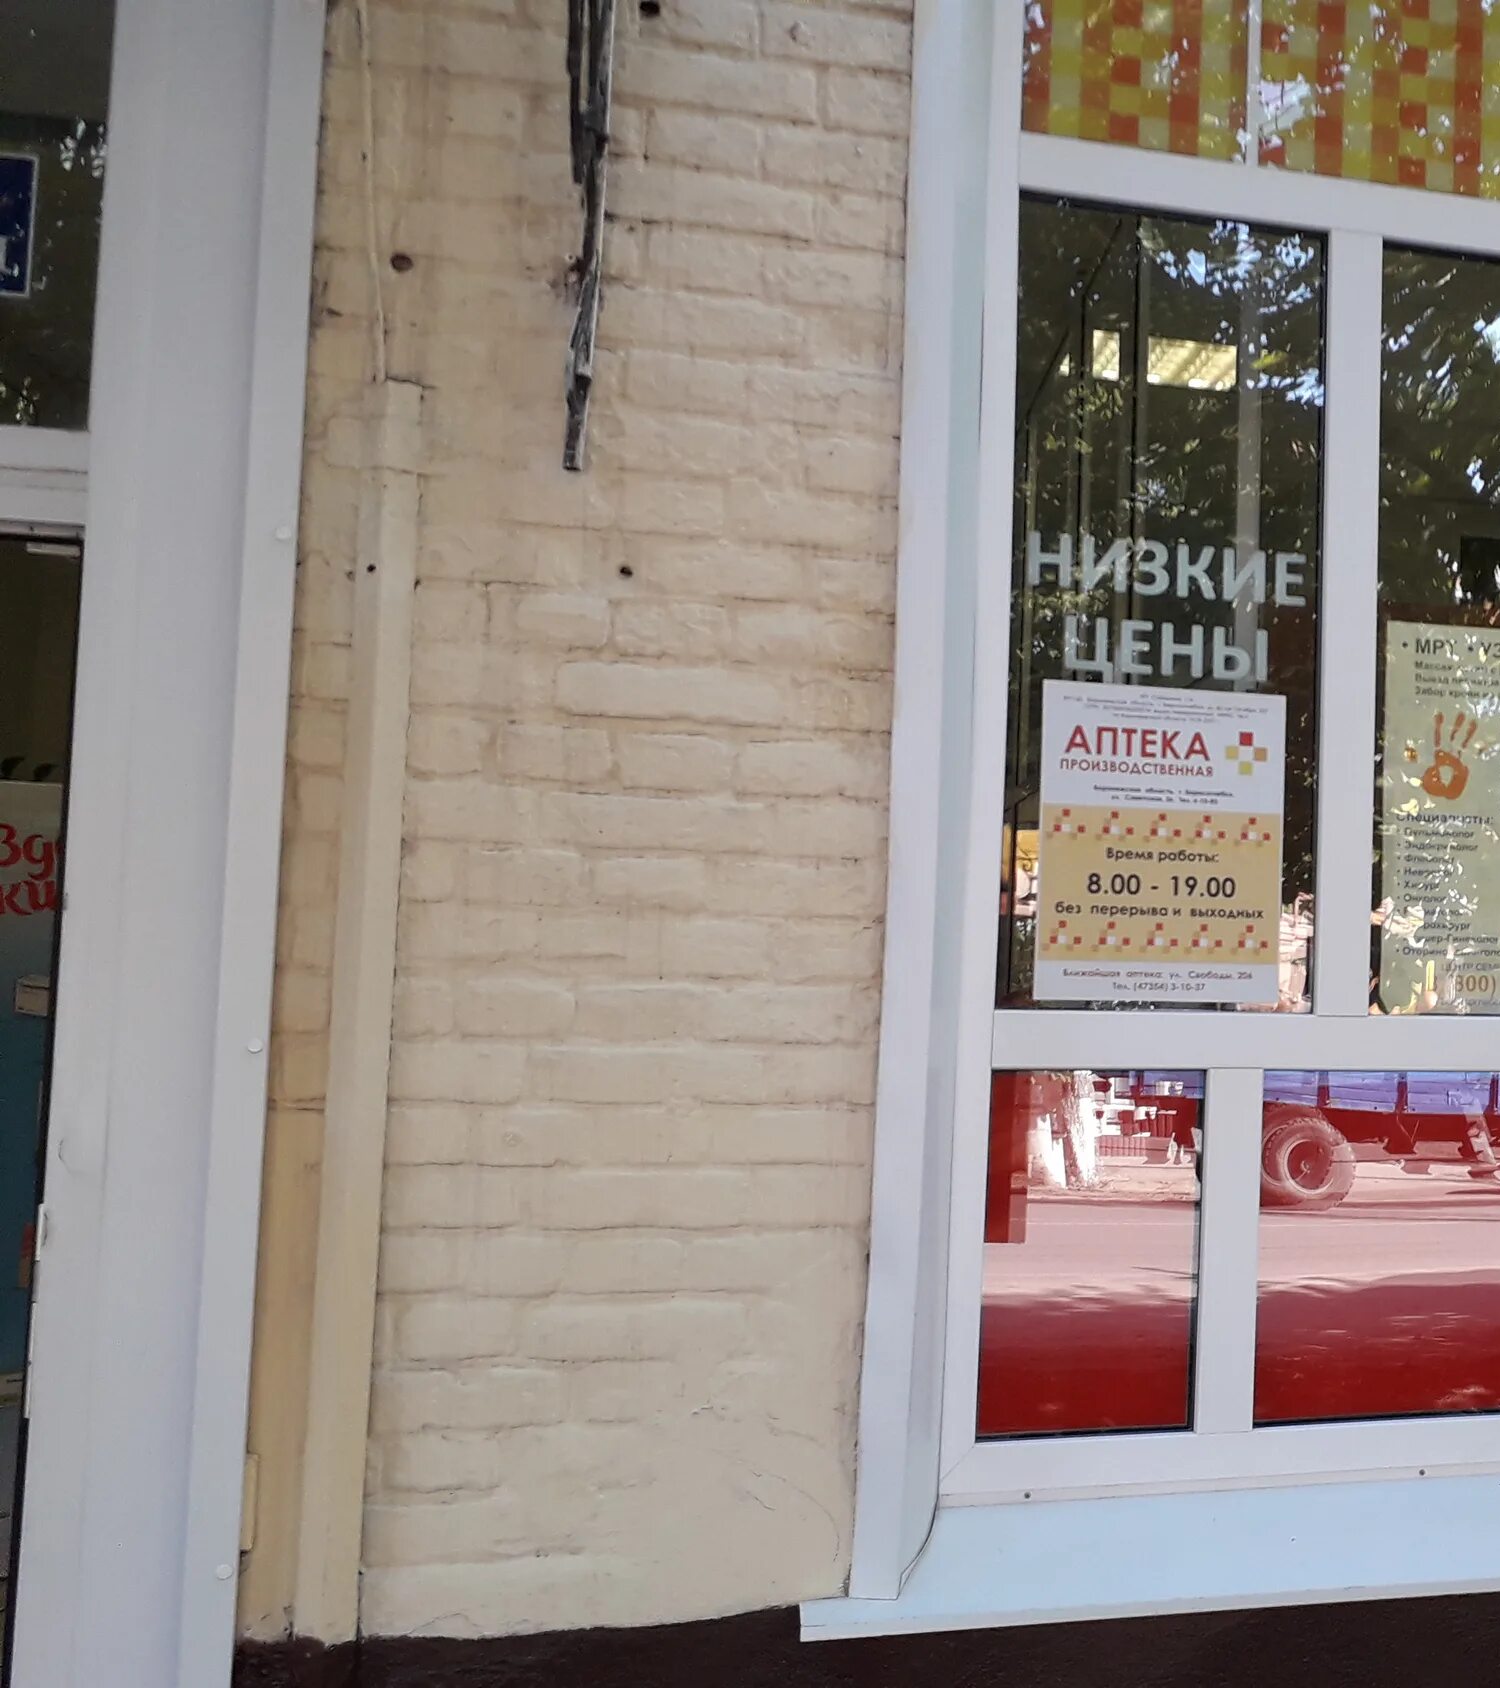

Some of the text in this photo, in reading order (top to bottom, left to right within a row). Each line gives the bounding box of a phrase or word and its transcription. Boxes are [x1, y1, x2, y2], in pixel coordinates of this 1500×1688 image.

[1027, 531, 1306, 607] НИЗКИЕ
[1064, 614, 1269, 683] ЦЕНЫ
[1064, 725, 1211, 761] АПТЕКА
[1060, 758, 1213, 778] ПРОИЗВОДСТВЕННАЯ
[1158, 849, 1219, 863] работы:
[1087, 873, 1141, 895] 8.00
[1170, 876, 1236, 898] 19.00
[1055, 902, 1264, 920] без перерыва и выходных
